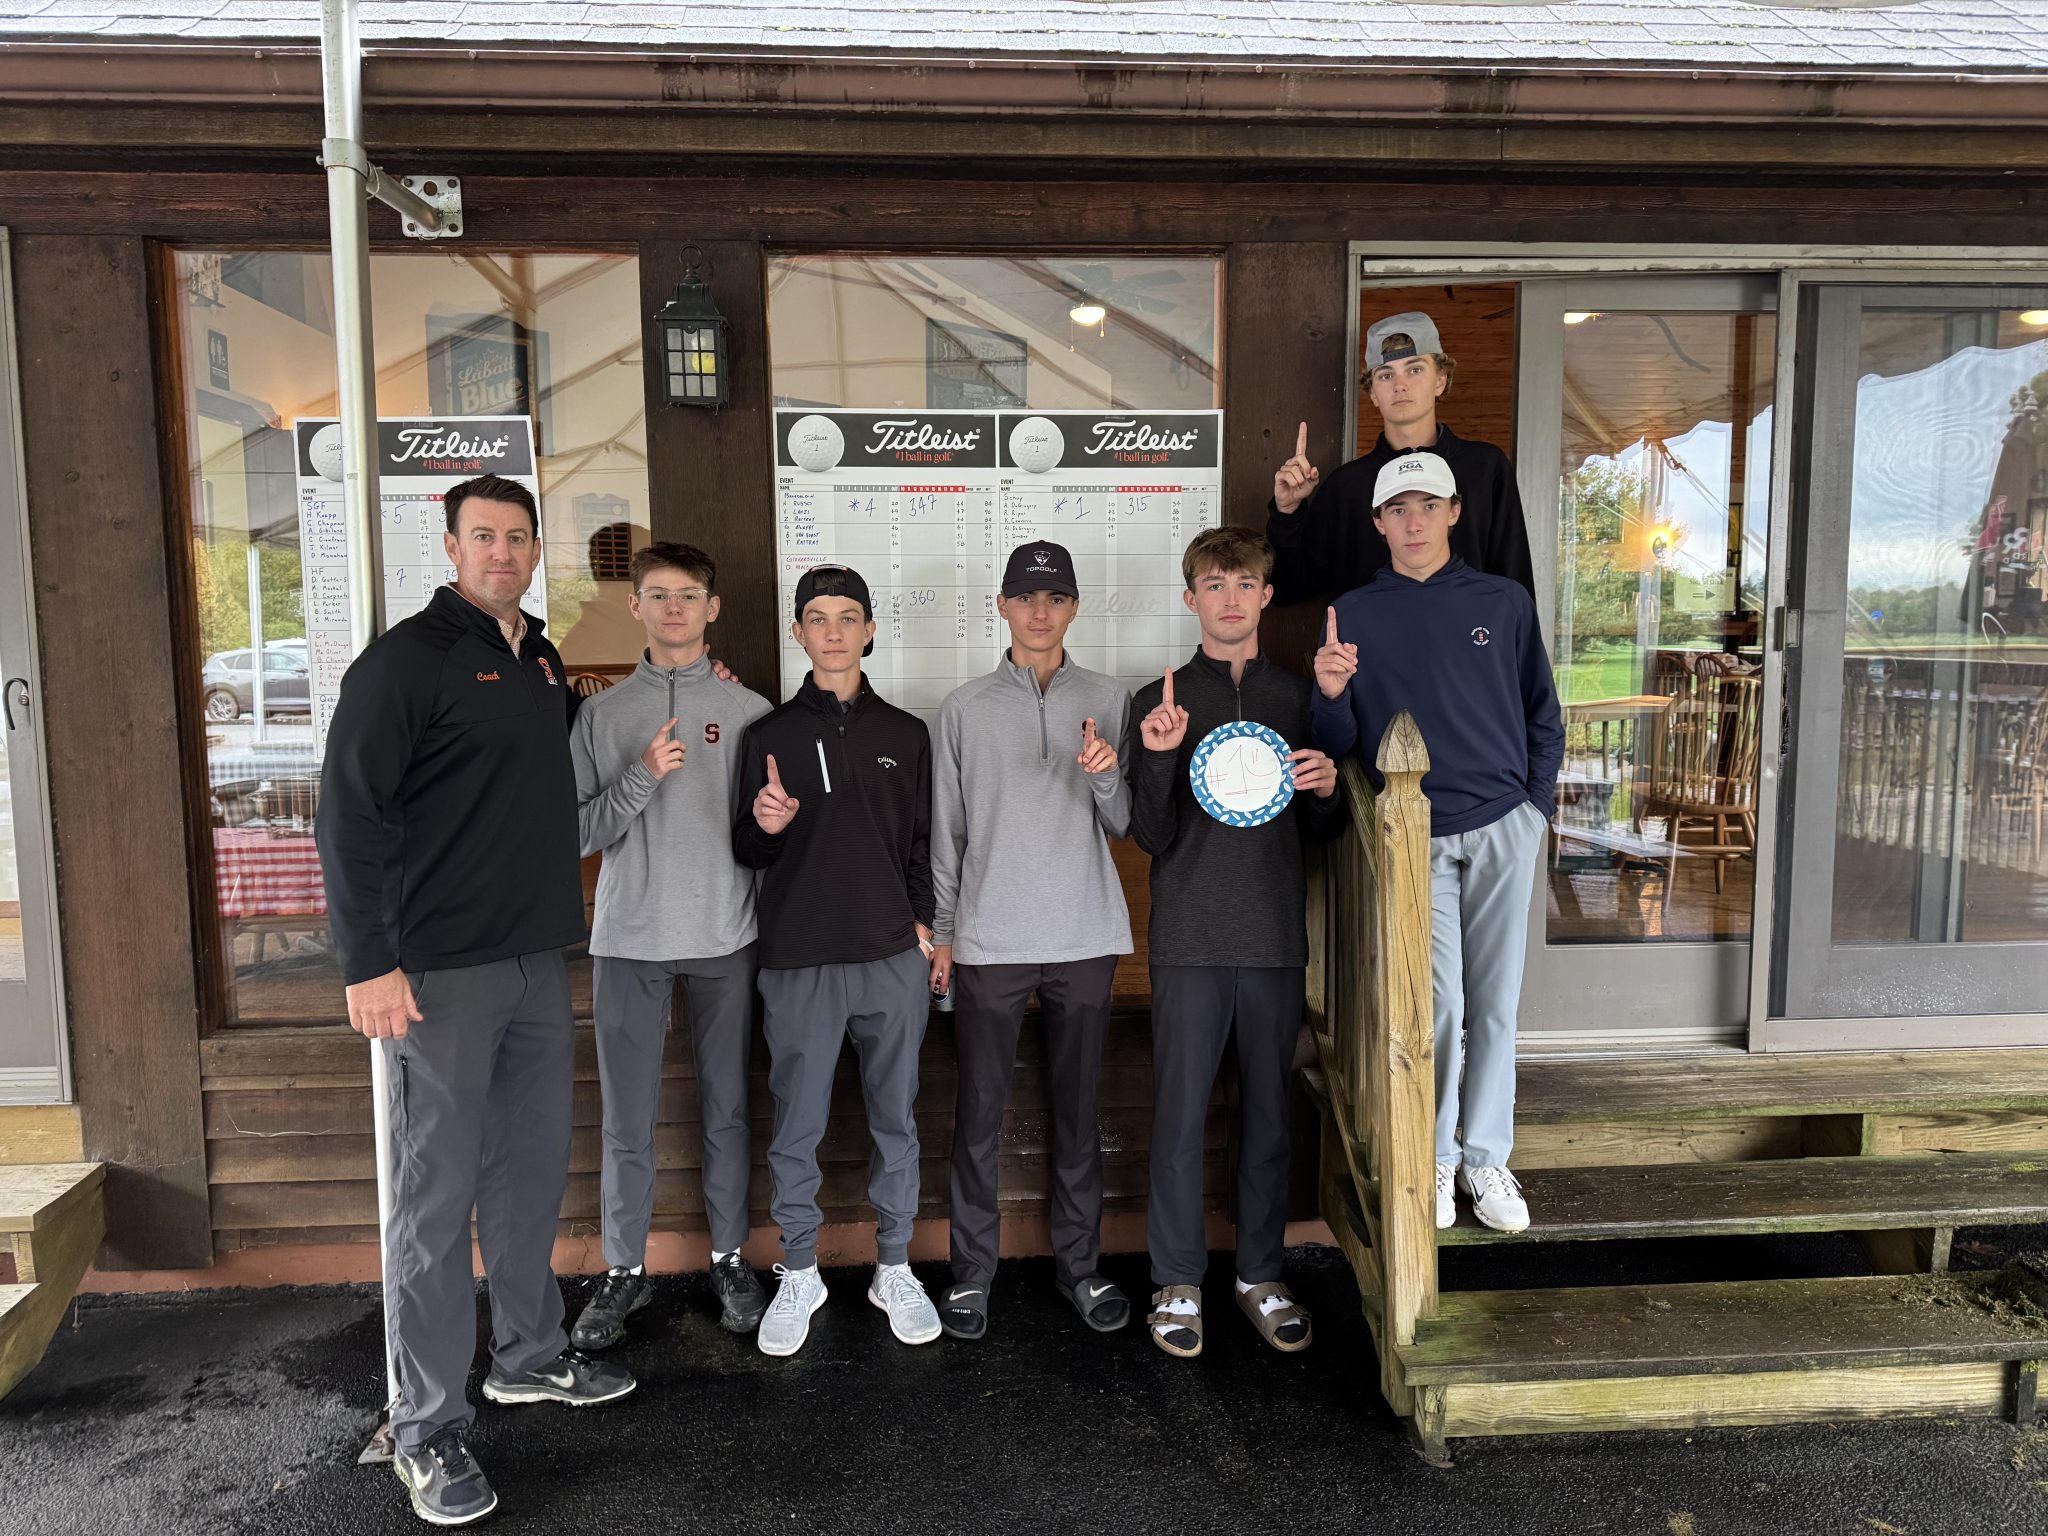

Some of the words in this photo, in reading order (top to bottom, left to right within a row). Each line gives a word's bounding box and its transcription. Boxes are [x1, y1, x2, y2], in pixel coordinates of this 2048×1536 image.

[457, 355, 515, 388] Labatt
[391, 427, 509, 462] Titleist
[865, 419, 980, 453] Titleist
[1084, 420, 1198, 454] Titleist
[433, 460, 450, 469] ball
[452, 460, 461, 469] in
[905, 452, 922, 461] ball
[924, 452, 932, 461] in
[1124, 453, 1140, 462] ball
[1142, 453, 1150, 462] in
[1399, 462, 1423, 471] PGA
[307, 501, 326, 510] SGF
[394, 503, 406, 524] 5
[865, 498, 876, 517] 4
[1124, 495, 1152, 515] 315
[704, 723, 720, 744] S
